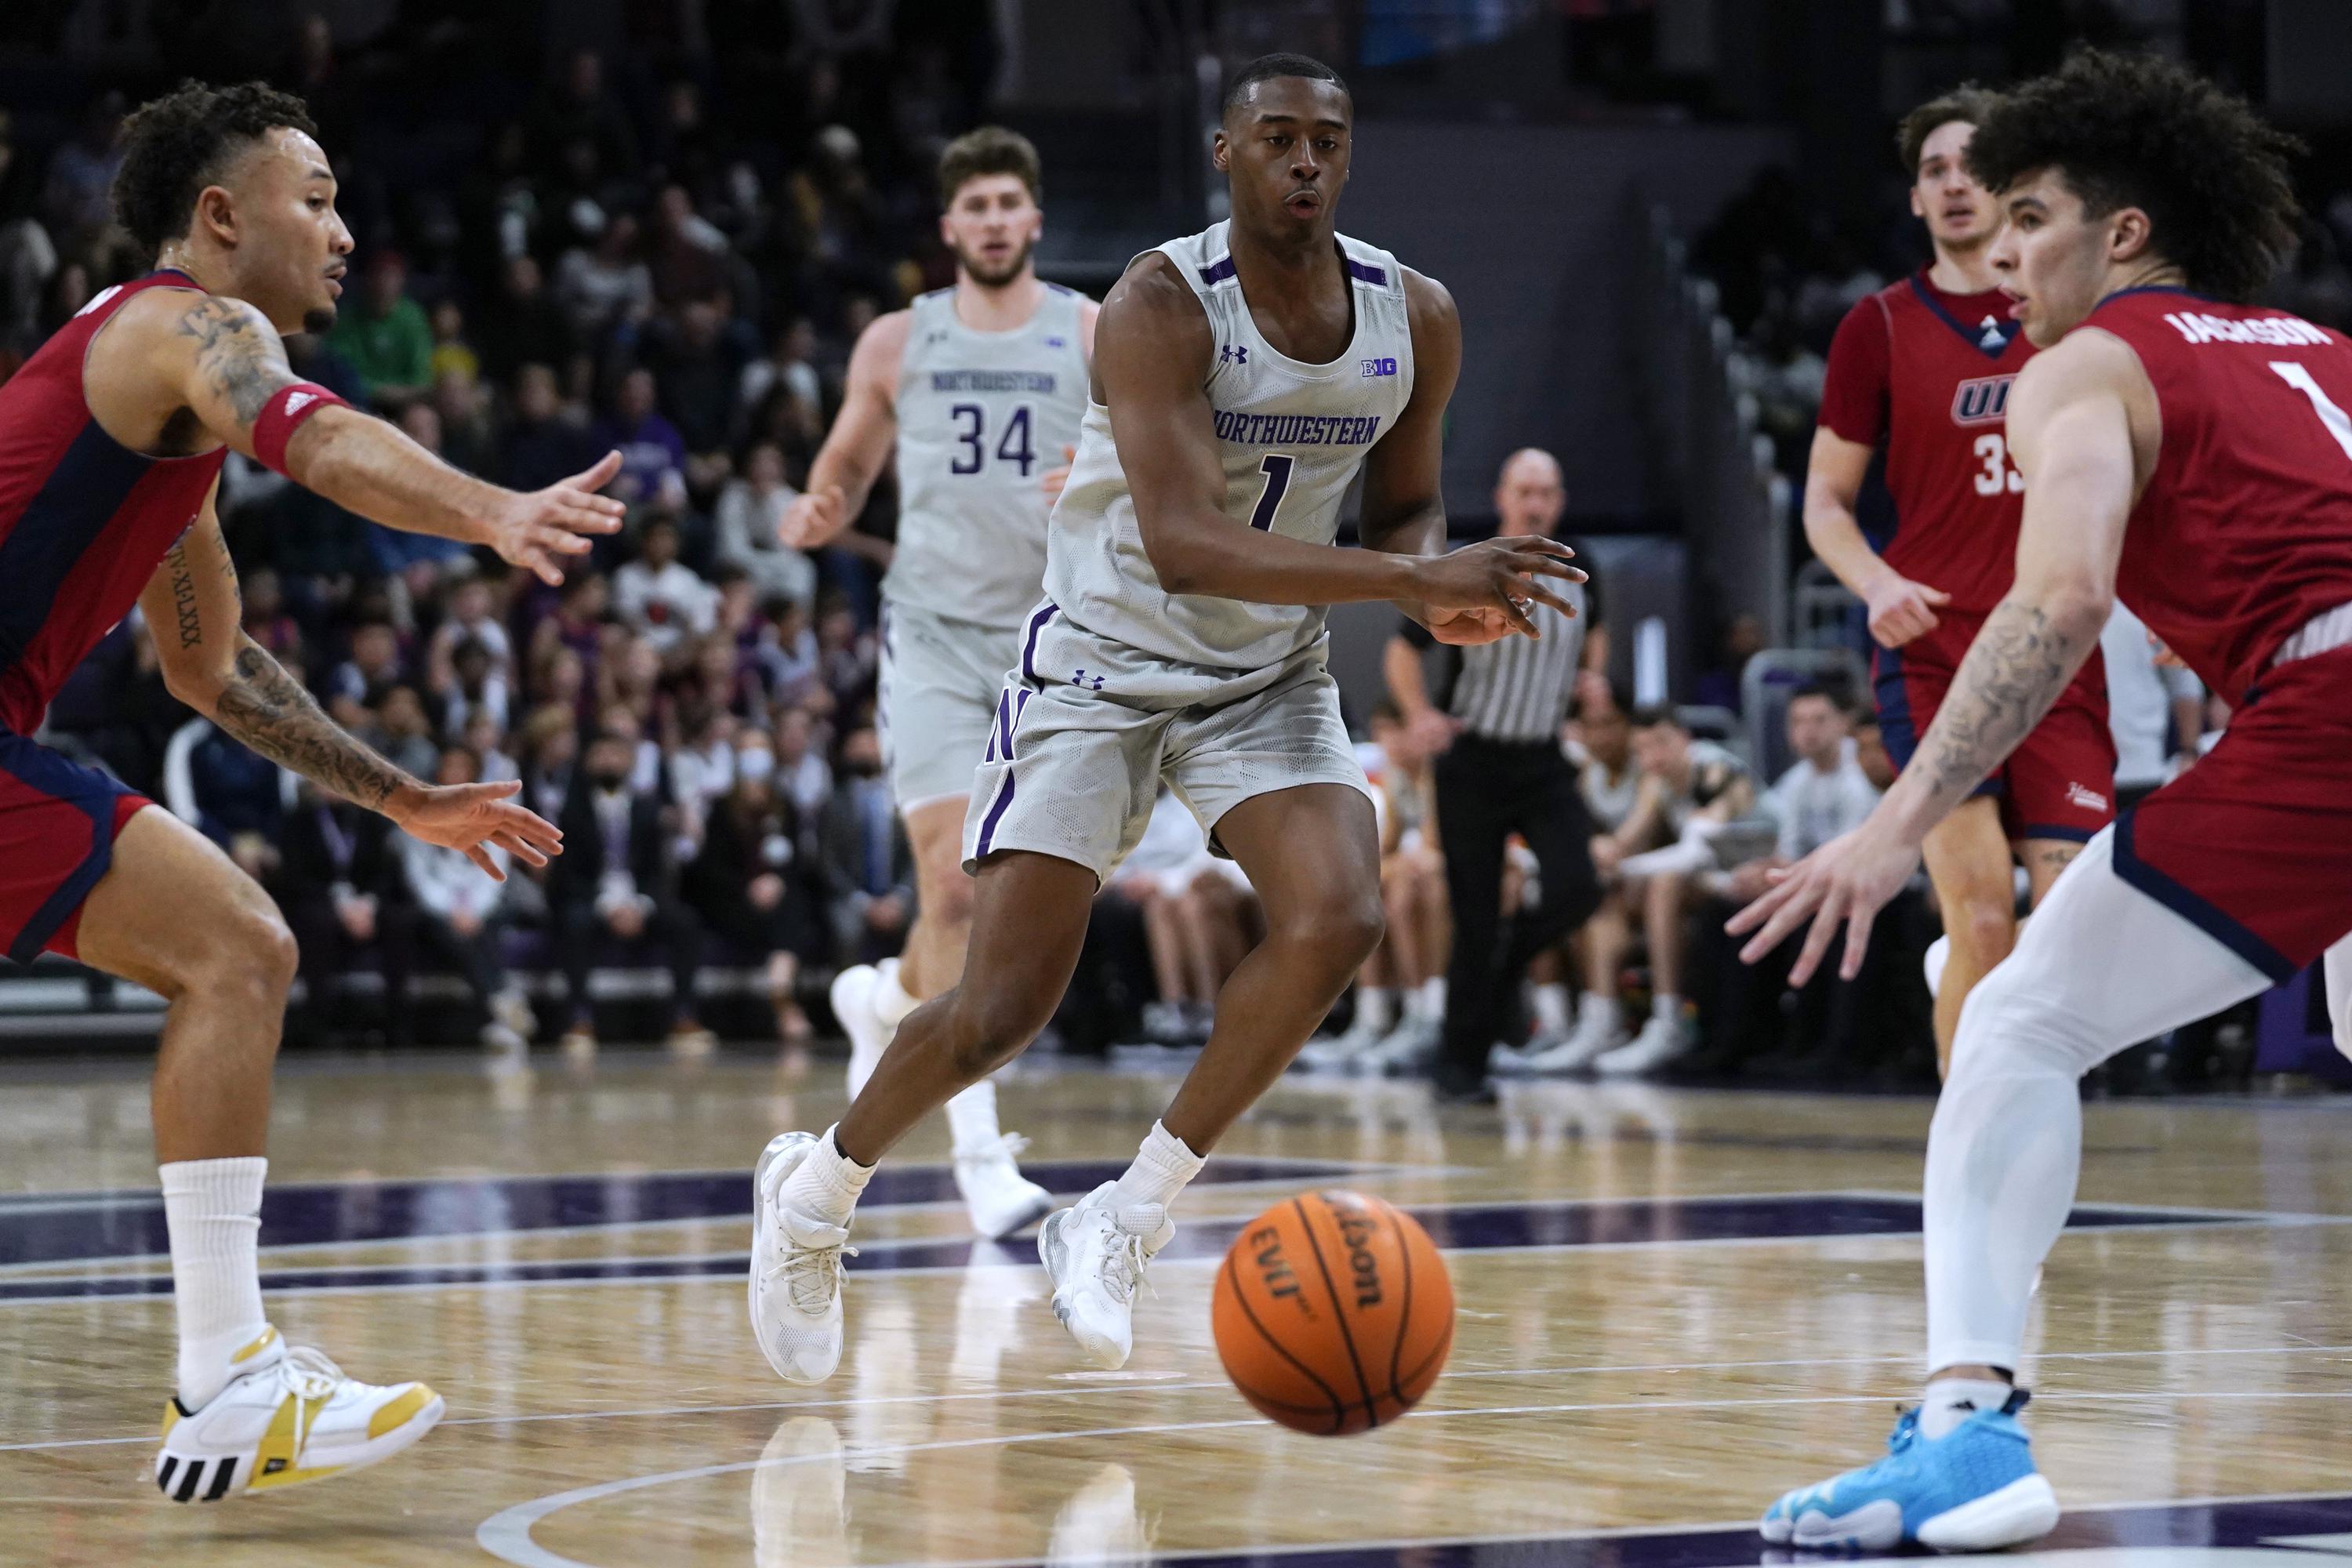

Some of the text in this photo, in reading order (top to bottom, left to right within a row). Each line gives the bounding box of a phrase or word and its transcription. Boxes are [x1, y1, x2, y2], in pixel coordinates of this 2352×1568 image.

[1957, 378, 2013, 420] UI
[2268, 361, 2352, 462] 1
[952, 402, 1036, 477] 34
[1248, 453, 1296, 532] 1
[984, 685, 1036, 765] N
